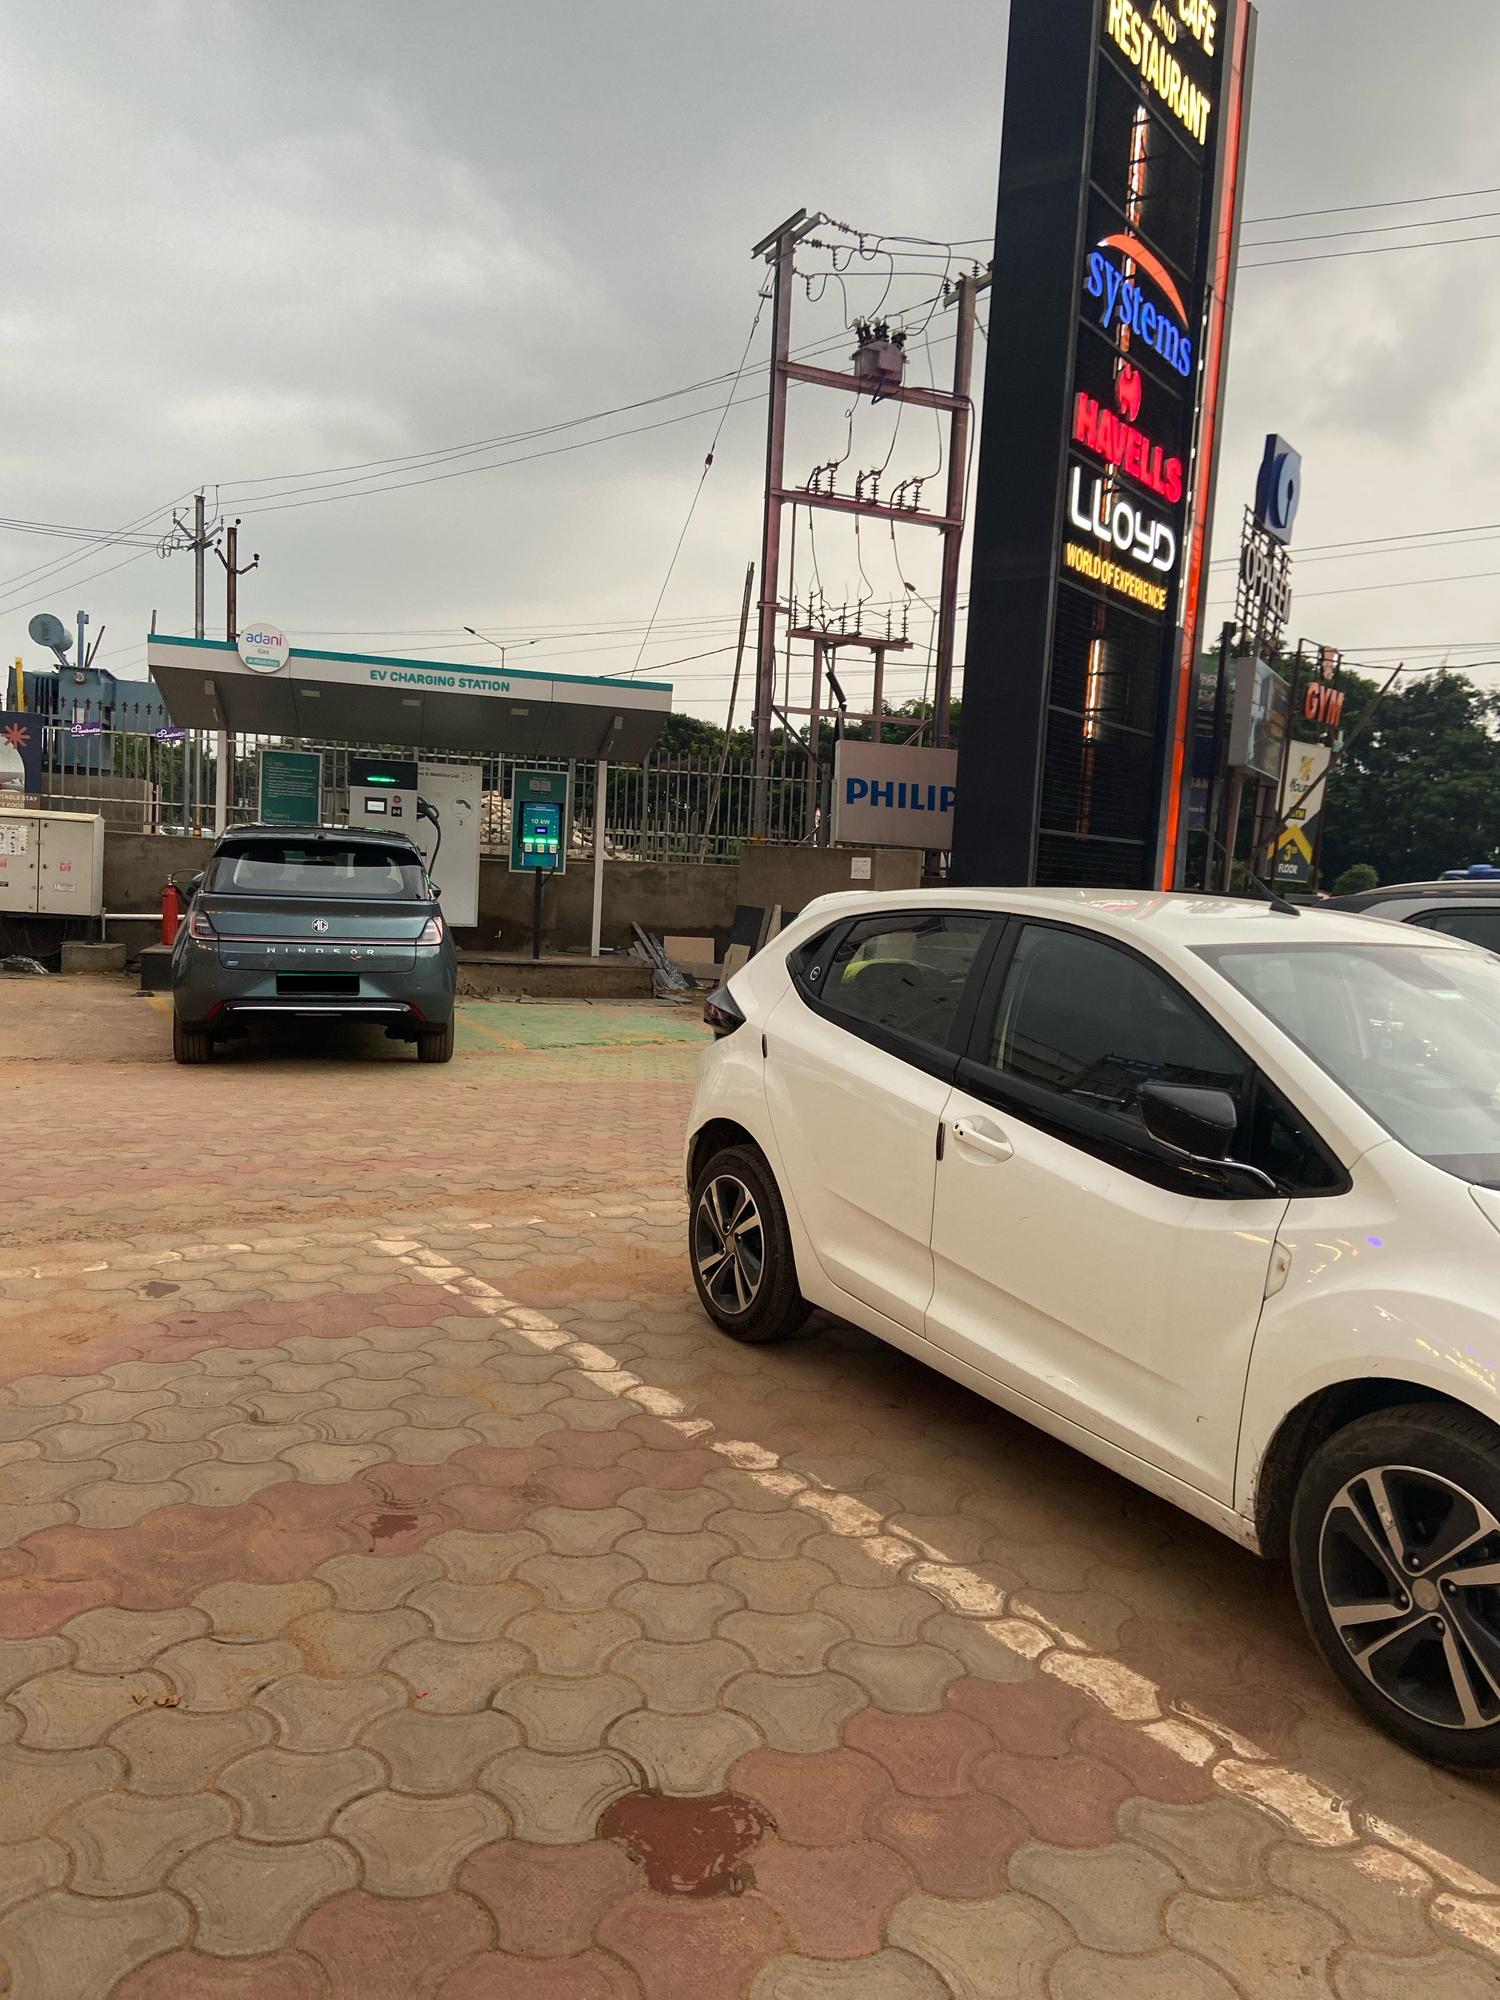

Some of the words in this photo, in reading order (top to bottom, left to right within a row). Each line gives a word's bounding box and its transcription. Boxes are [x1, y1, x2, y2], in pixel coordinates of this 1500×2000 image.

[1152, 0, 1177, 44] AND
[1107, 0, 1211, 145] RESTAURANT
[1087, 251, 1192, 376] systems
[1074, 391, 1182, 503] HAVELLS
[1071, 465, 1175, 572] LLOYD
[1065, 542, 1101, 580] WORLD
[1101, 560, 1115, 585] OF
[1113, 566, 1167, 611] EXPERIENCE
[245, 631, 283, 646] adani
[369, 669, 387, 681] EV
[389, 671, 456, 687] CHARGING
[458, 677, 510, 692] STATION
[1305, 682, 1344, 727] GYM
[1278, 863, 1299, 875] FLOOR
[312, 918, 328, 932] MG
[266, 947, 375, 956] WINDSOR
